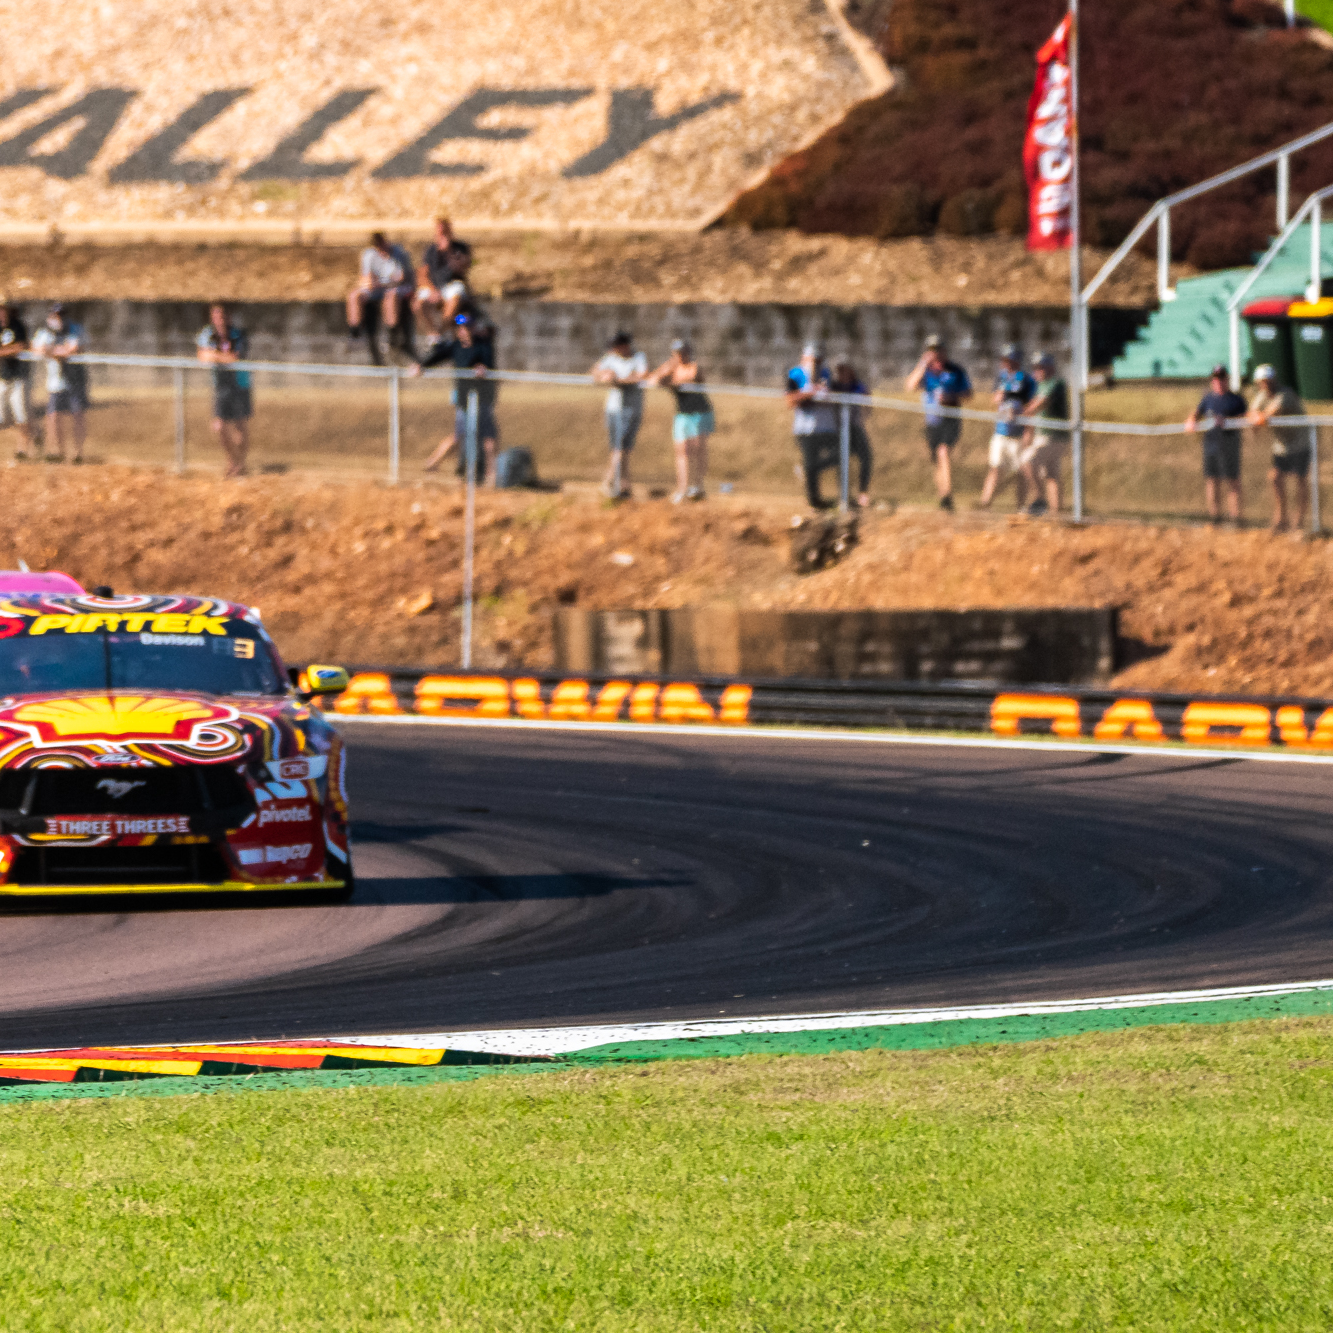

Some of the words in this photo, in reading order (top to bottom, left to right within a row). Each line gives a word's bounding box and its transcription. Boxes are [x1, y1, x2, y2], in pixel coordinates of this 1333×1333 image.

[29, 612, 230, 635] PIRTEK
[140, 632, 205, 646] Davison
[296, 672, 753, 724] ARWIN
[60, 820, 111, 835] THREE
[116, 818, 178, 834] THREES
